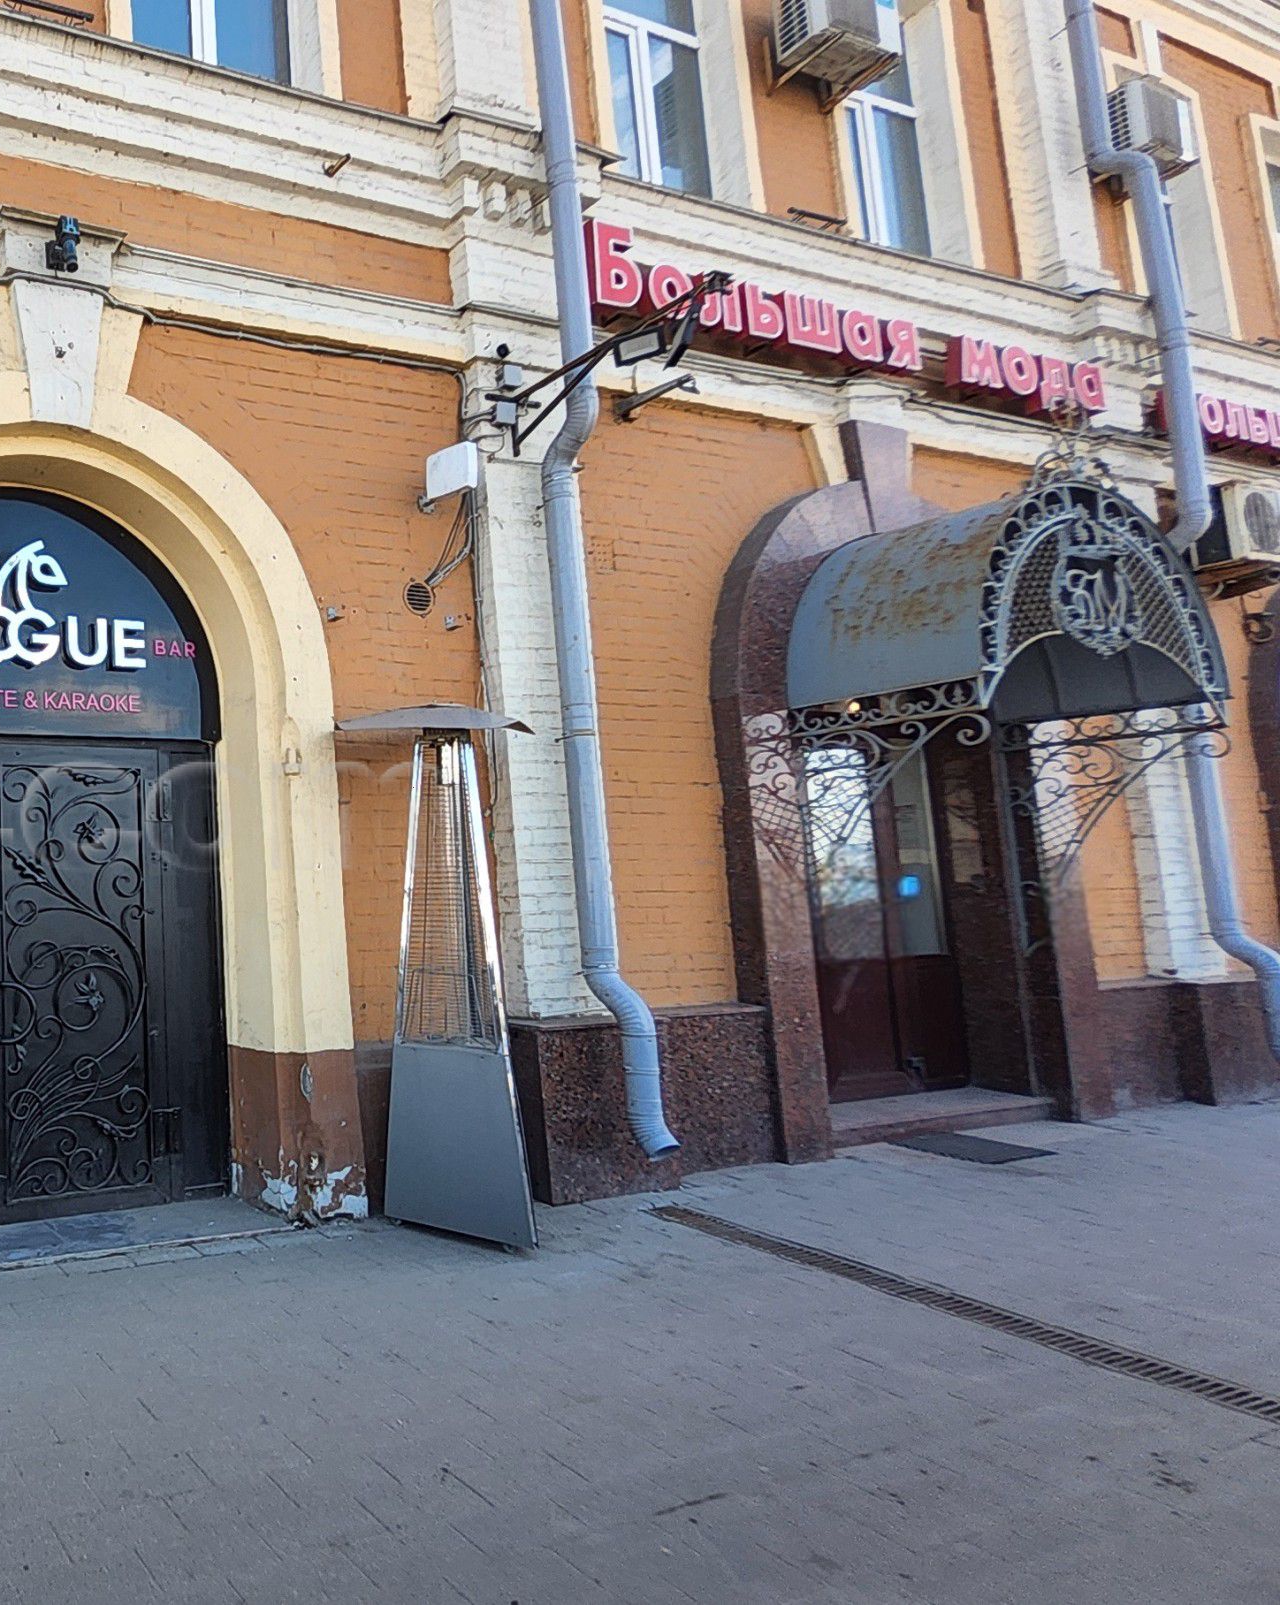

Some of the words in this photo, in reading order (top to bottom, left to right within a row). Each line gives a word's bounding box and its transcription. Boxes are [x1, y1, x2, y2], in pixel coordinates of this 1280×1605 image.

[153, 638, 198, 659] BAR
[23, 690, 40, 710] &
[43, 690, 142, 713] KARAOKE
